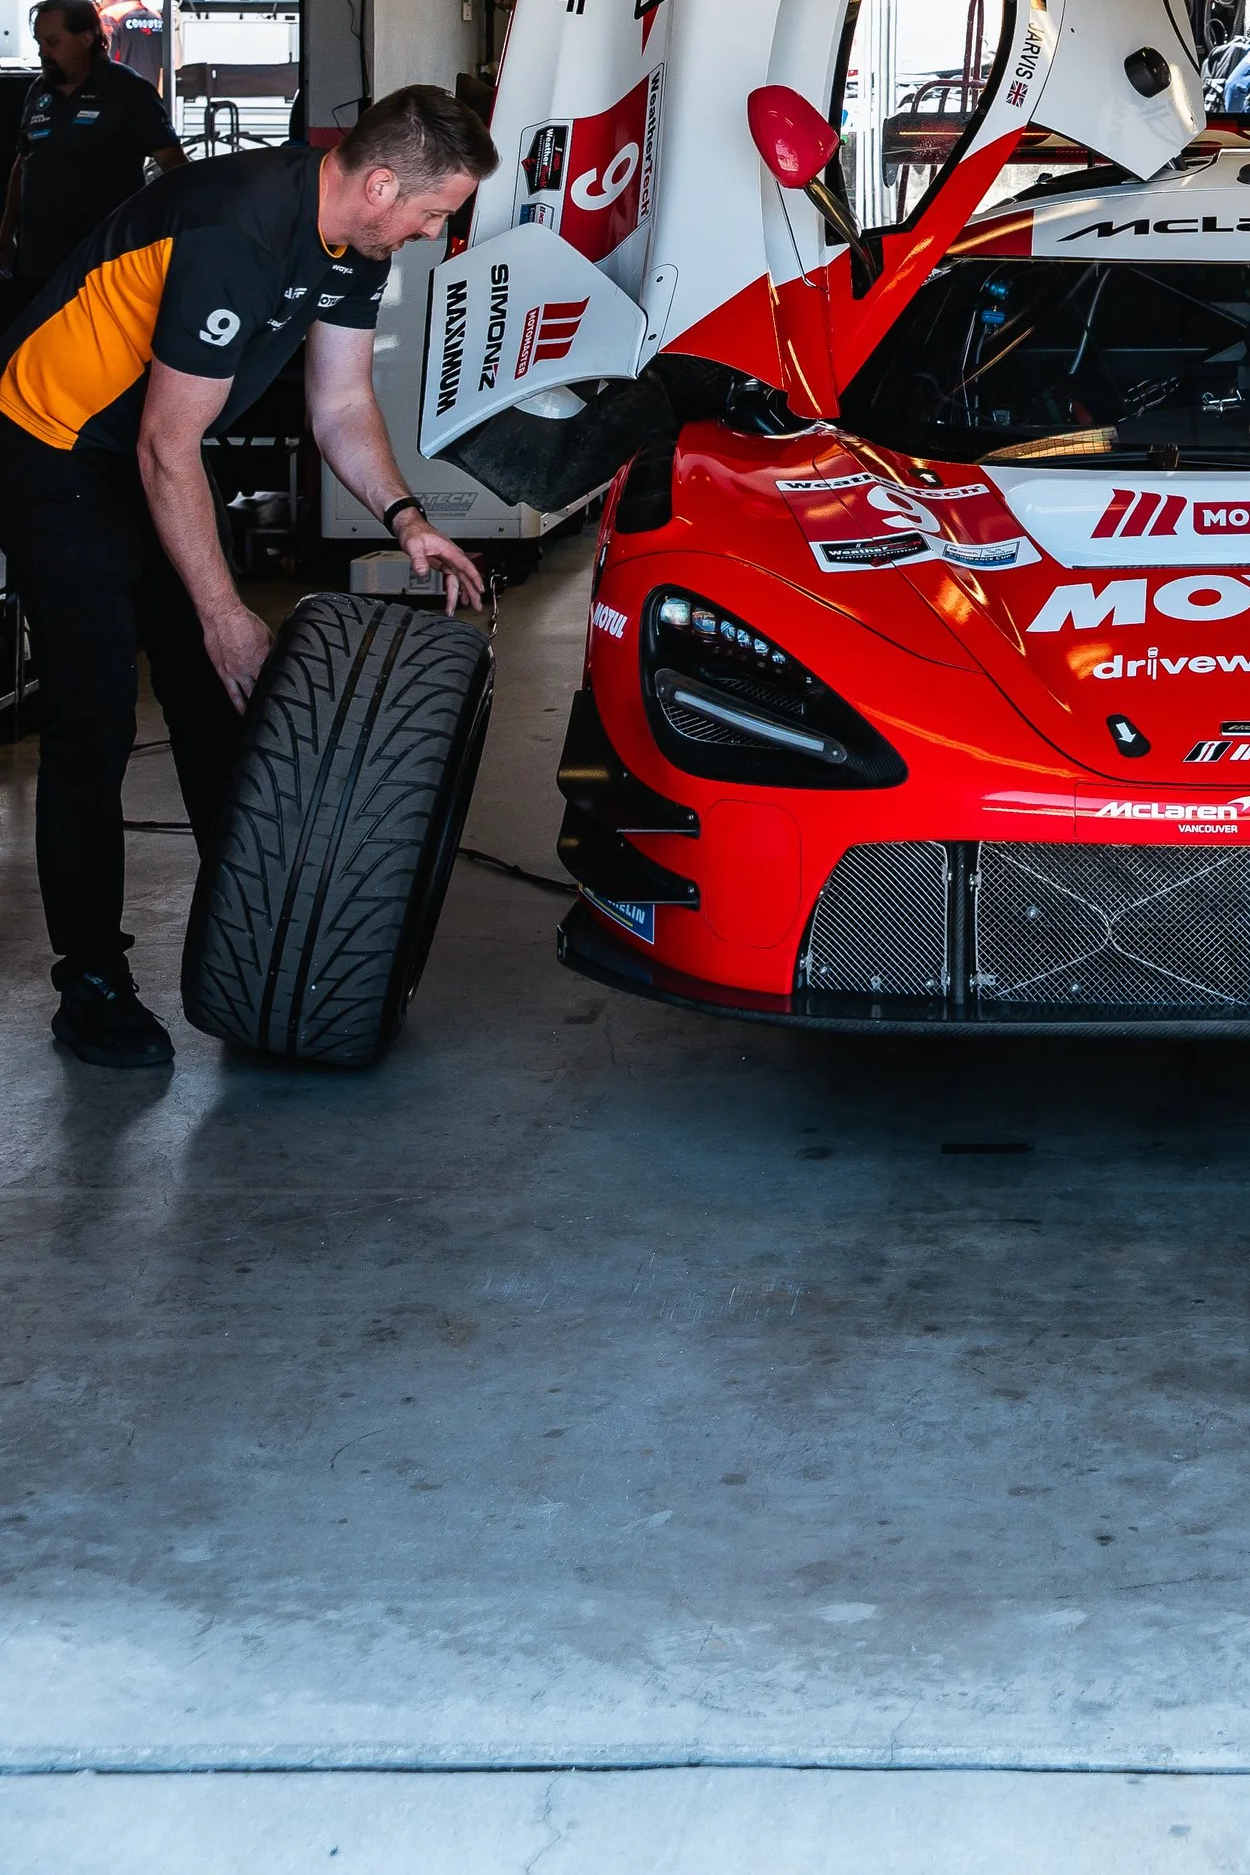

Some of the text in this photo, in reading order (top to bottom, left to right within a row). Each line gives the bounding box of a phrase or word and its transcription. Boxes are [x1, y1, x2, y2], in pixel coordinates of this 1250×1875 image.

[1016, 22, 1044, 79] JARVIS
[640, 71, 661, 218] WeatherTech
[570, 142, 640, 211] 9
[199, 308, 241, 347] 9
[436, 280, 467, 417] MAXIMUM
[517, 310, 537, 375] MOTOMASTER
[867, 485, 941, 533] 9
[593, 602, 628, 639] MOTUL
[1095, 799, 1239, 821] McLaren
[1178, 824, 1239, 834] VANCOUVER
